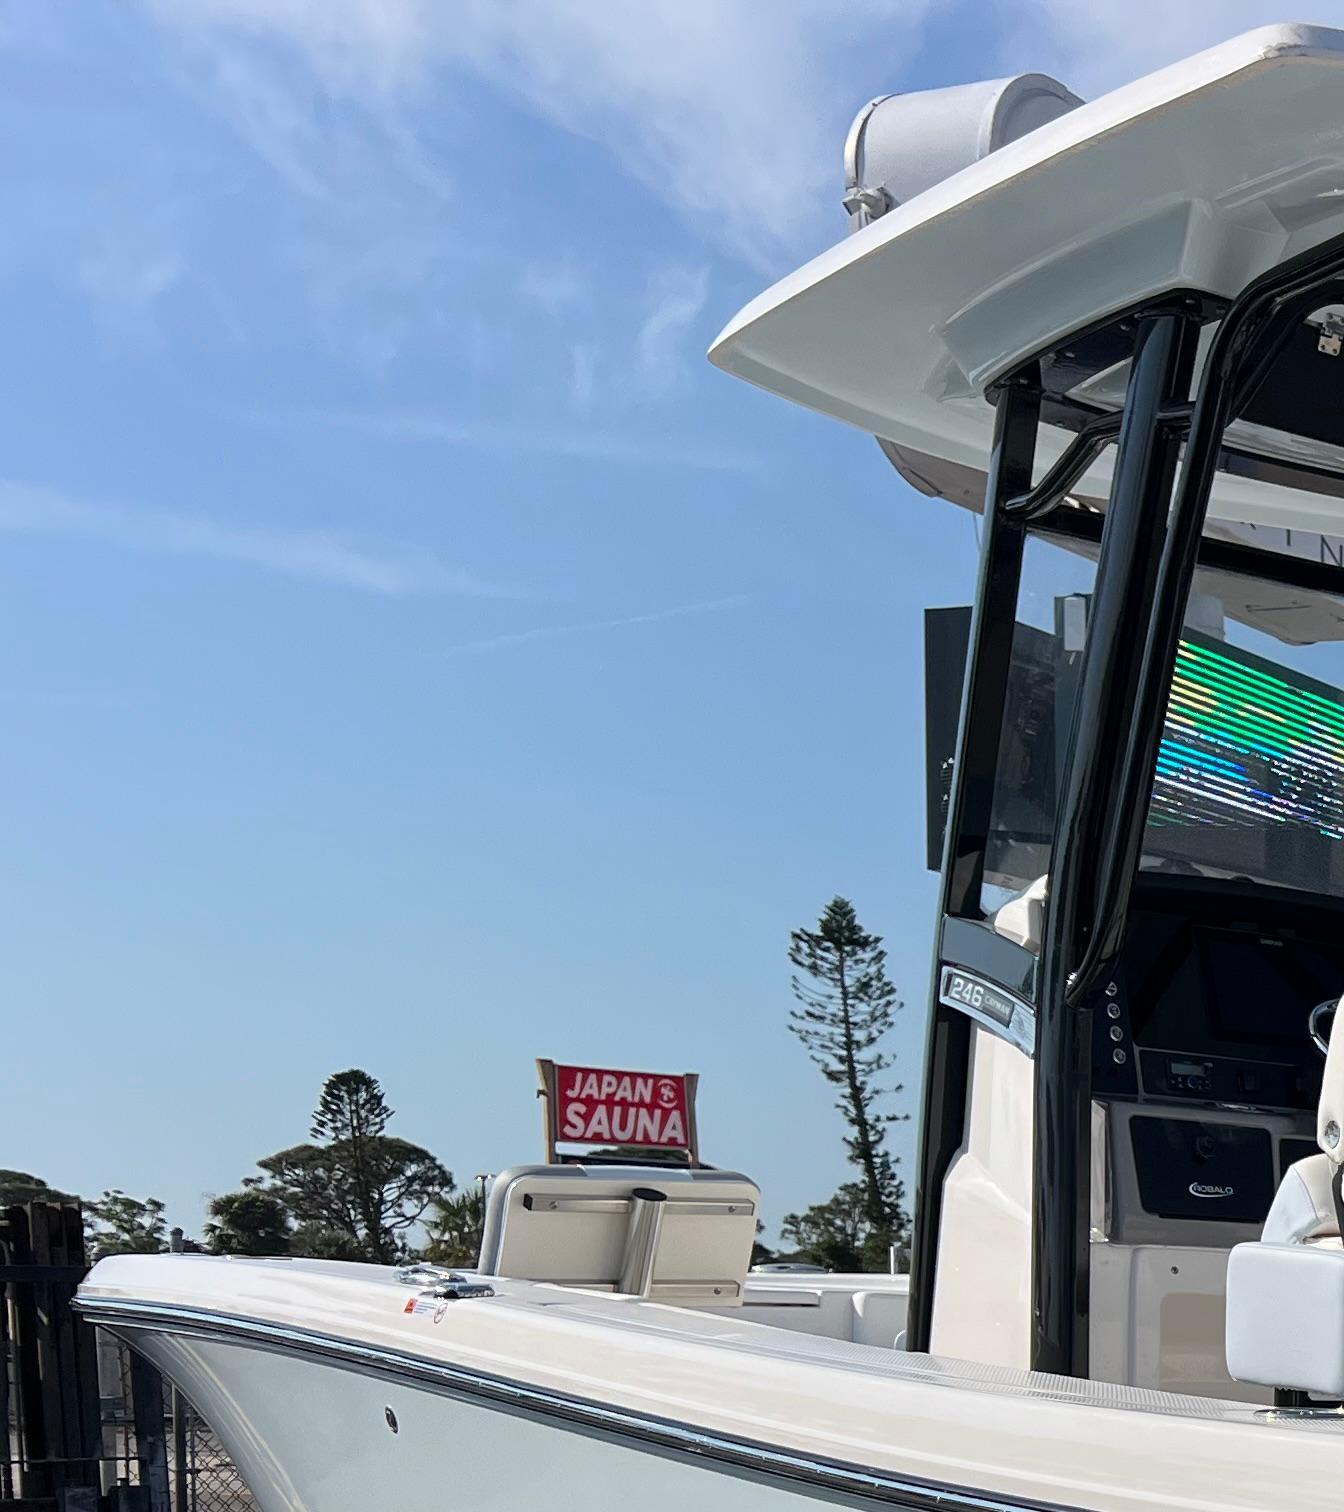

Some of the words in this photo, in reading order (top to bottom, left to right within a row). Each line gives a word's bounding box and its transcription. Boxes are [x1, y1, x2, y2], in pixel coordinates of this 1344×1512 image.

[950, 976, 985, 1008] 246
[565, 1071, 654, 1104] JAPAN
[562, 1101, 687, 1145] SAUNA
